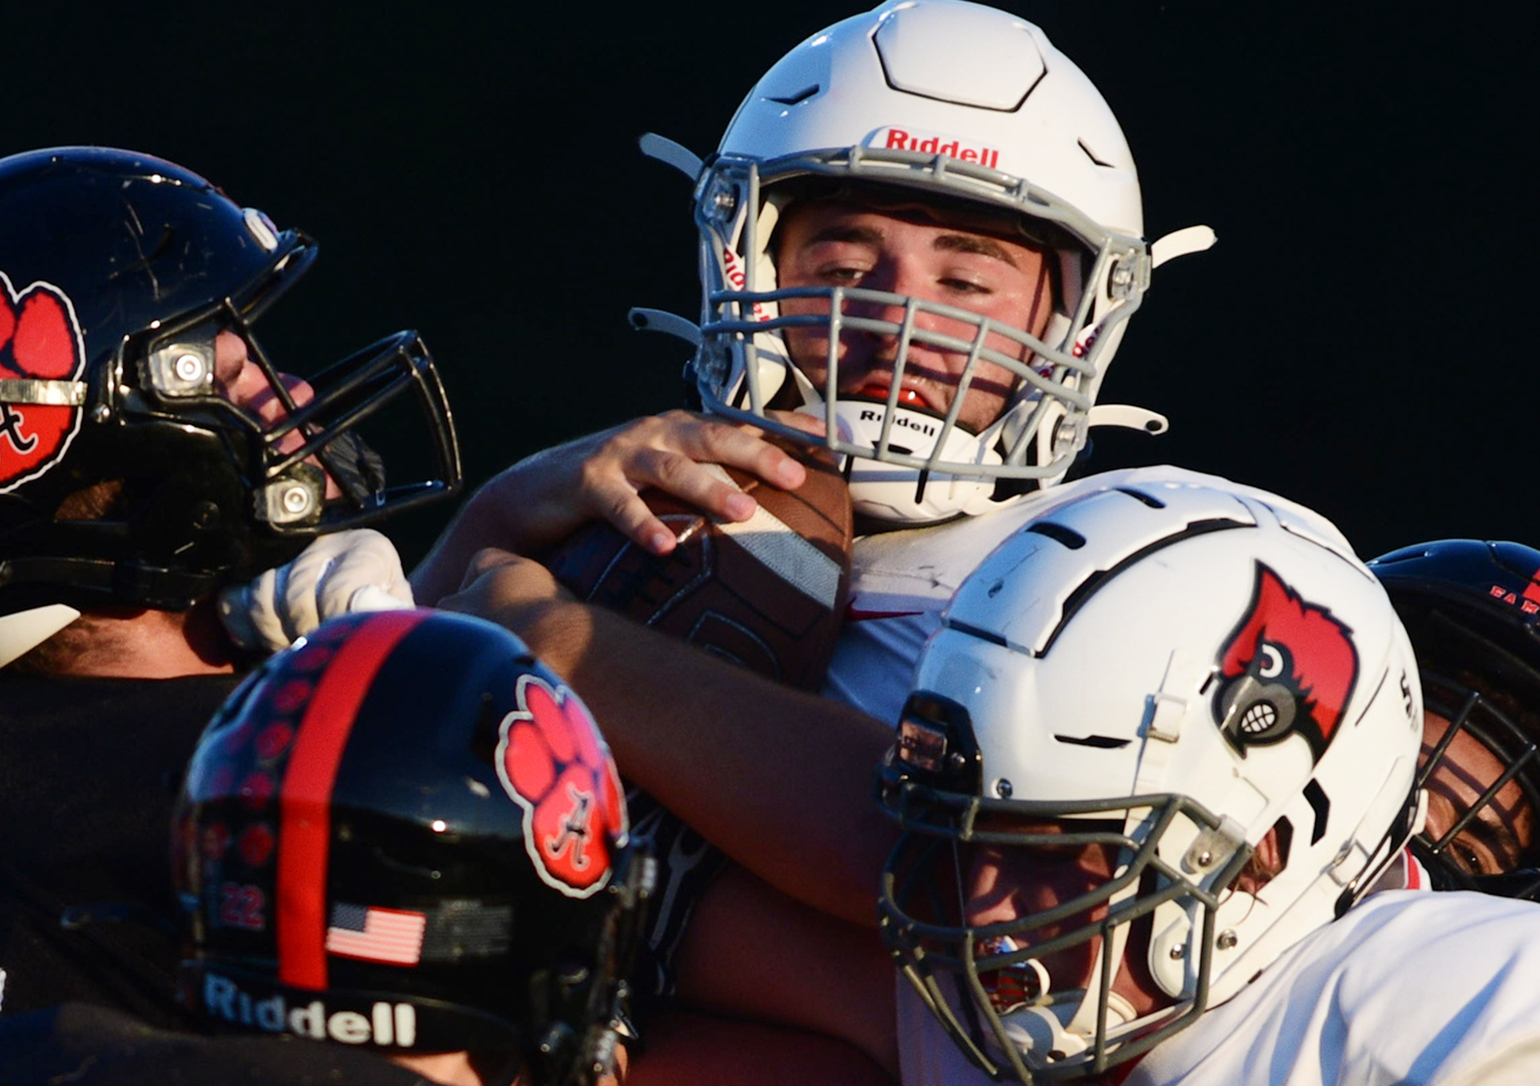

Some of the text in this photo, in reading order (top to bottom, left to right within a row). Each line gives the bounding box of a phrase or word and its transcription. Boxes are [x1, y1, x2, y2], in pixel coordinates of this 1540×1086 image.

[886, 129, 999, 169] Riddell
[860, 410, 935, 437] Ridell
[203, 972, 417, 1048] Riddell
